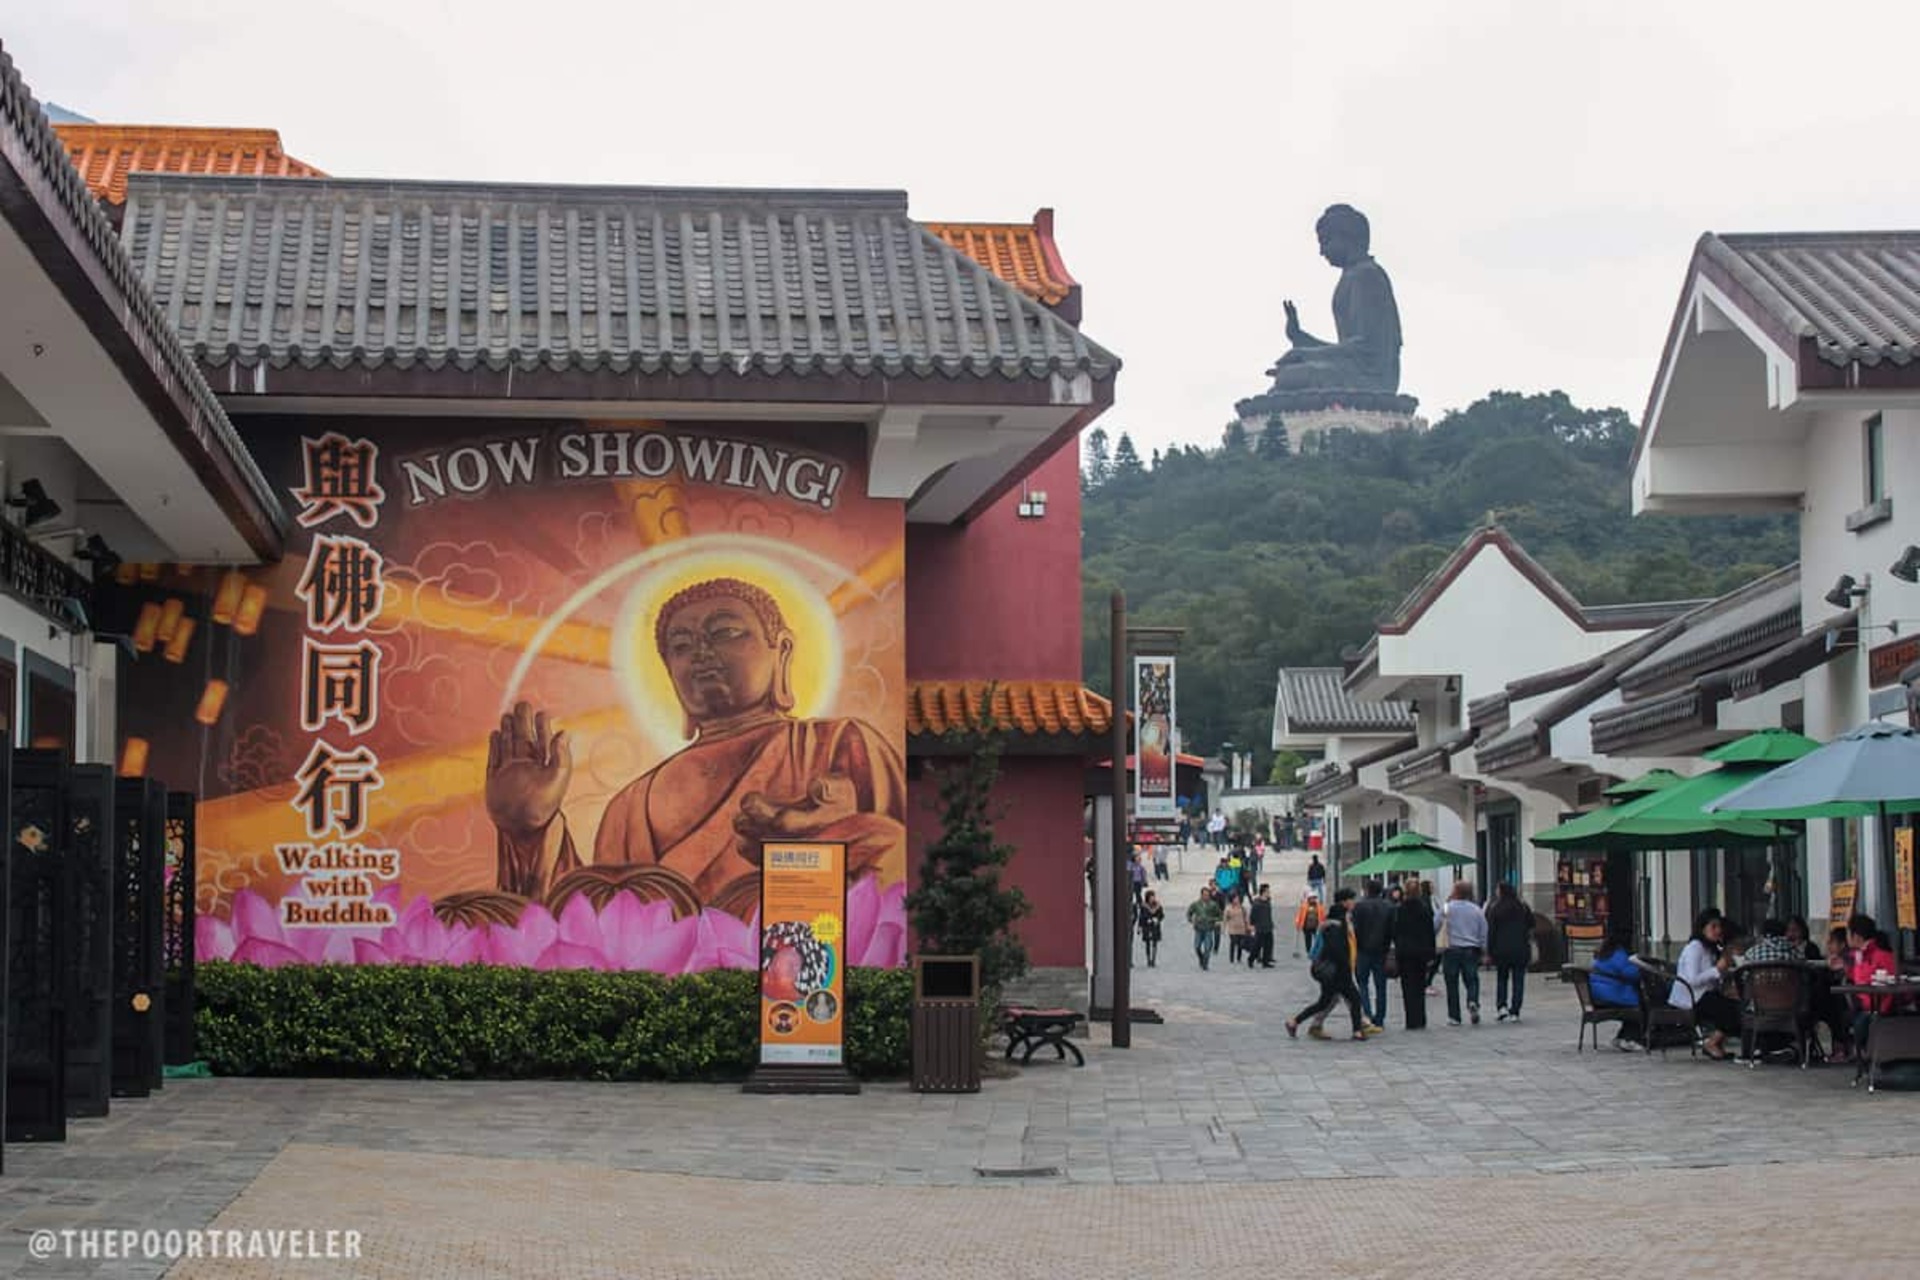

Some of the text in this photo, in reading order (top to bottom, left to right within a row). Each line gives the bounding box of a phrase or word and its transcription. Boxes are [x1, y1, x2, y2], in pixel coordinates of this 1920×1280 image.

[402, 432, 842, 508] NOW SHOWING!
[293, 435, 383, 836] 與佛同行
[278, 844, 397, 876] Walking
[306, 875, 368, 897] with
[285, 901, 391, 924] Buddha
